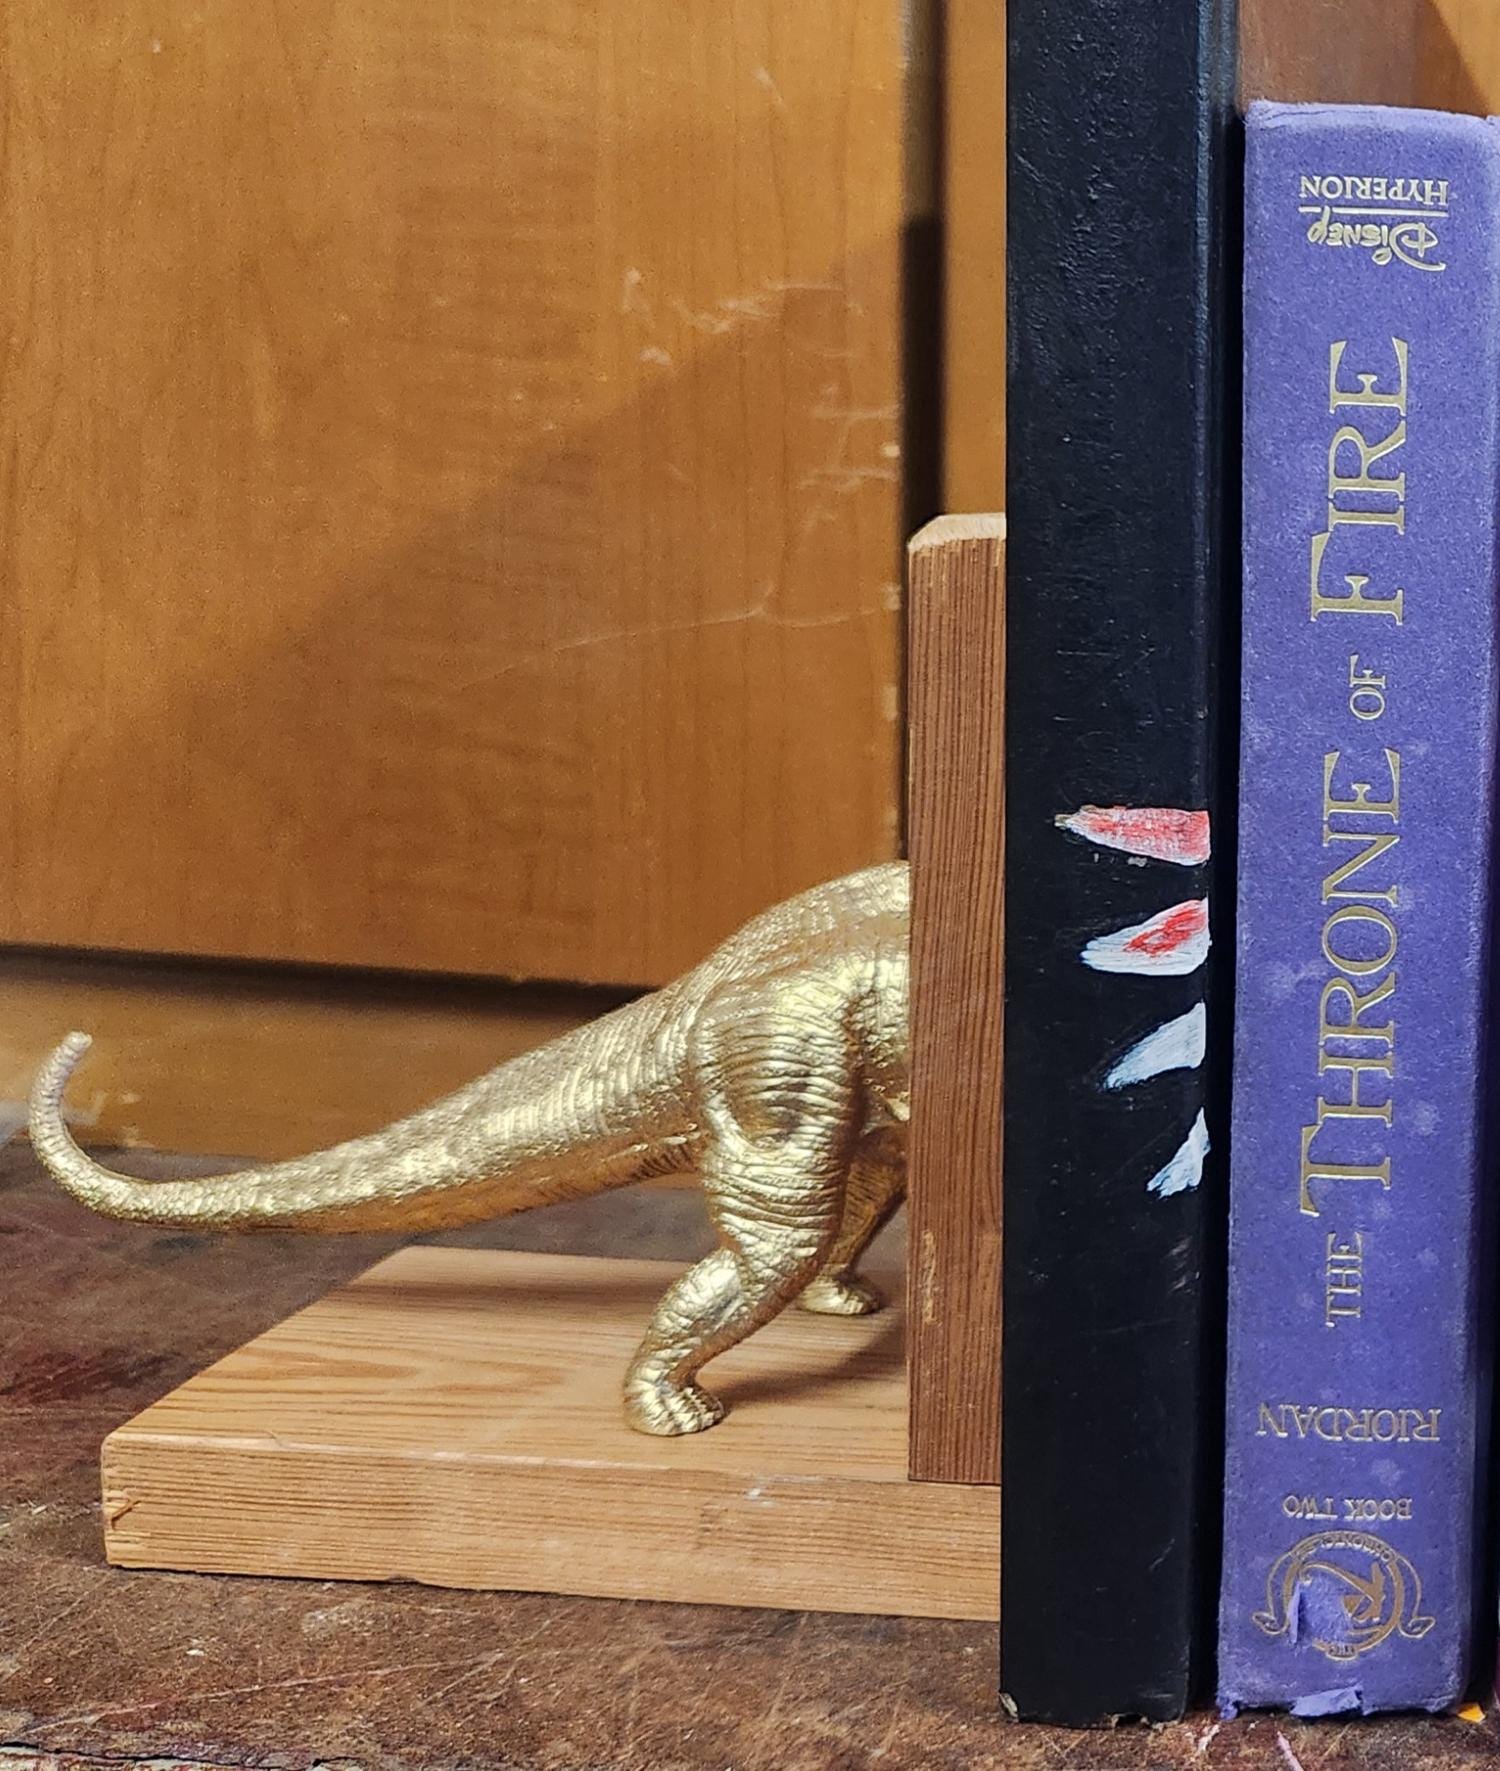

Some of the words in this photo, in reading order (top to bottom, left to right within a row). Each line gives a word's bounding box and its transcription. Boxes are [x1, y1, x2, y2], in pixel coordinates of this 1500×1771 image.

[1299, 175, 1449, 206] HYPERION
[1308, 335, 1410, 626] FIRE
[1348, 654, 1388, 721] OF
[1299, 747, 1402, 1219] THRONE
[1325, 1230, 1366, 1329] THE
[1255, 1402, 1443, 1443] RIORDAN
[1281, 1495, 1340, 1521] TWO
[1343, 1497, 1414, 1521] BOOK
